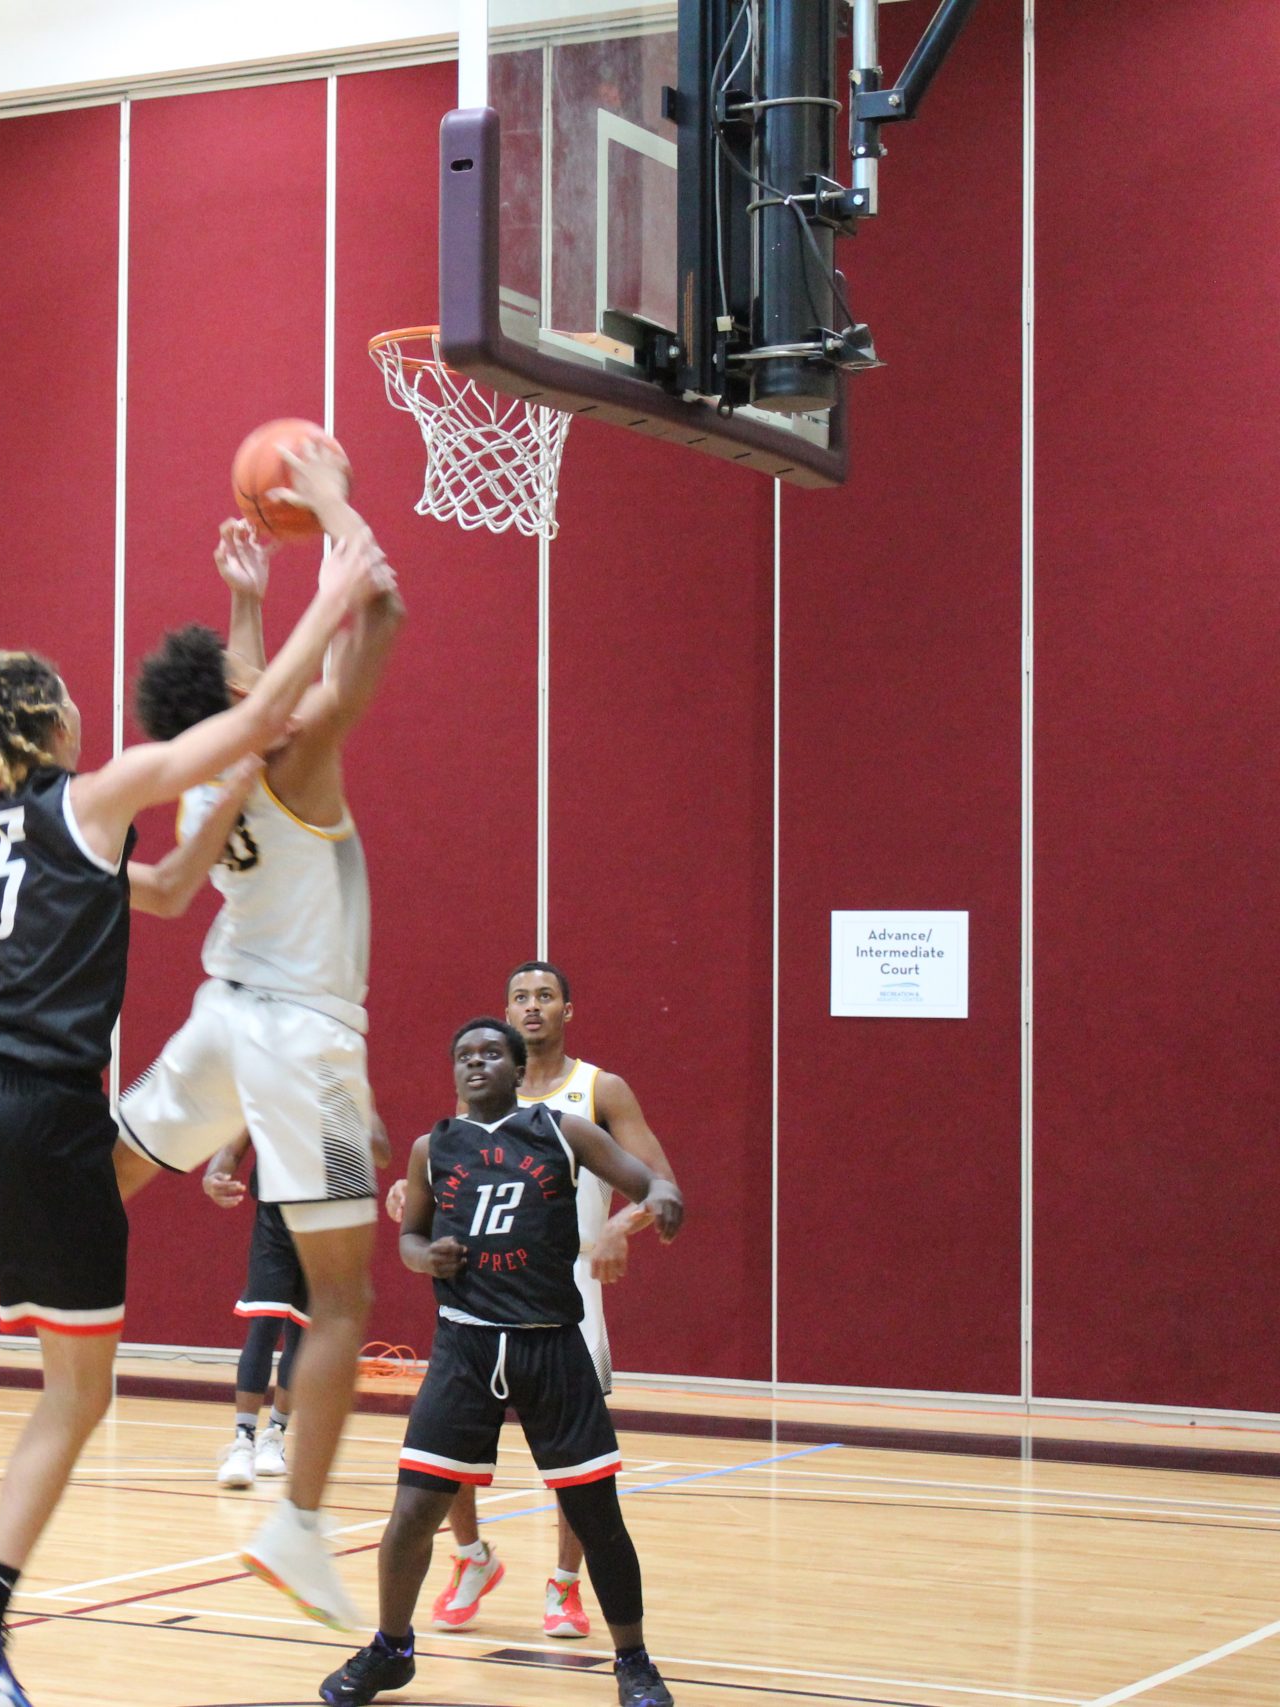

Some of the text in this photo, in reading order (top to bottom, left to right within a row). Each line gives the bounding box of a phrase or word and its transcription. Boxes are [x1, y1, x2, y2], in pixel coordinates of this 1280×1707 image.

[868, 928, 932, 942] Advance/
[856, 945, 945, 958] Intermediate
[880, 962, 920, 975] Court
[441, 1147, 558, 1211] TIME TO BALL
[469, 1181, 526, 1237] 12
[478, 1248, 529, 1272] PREP
